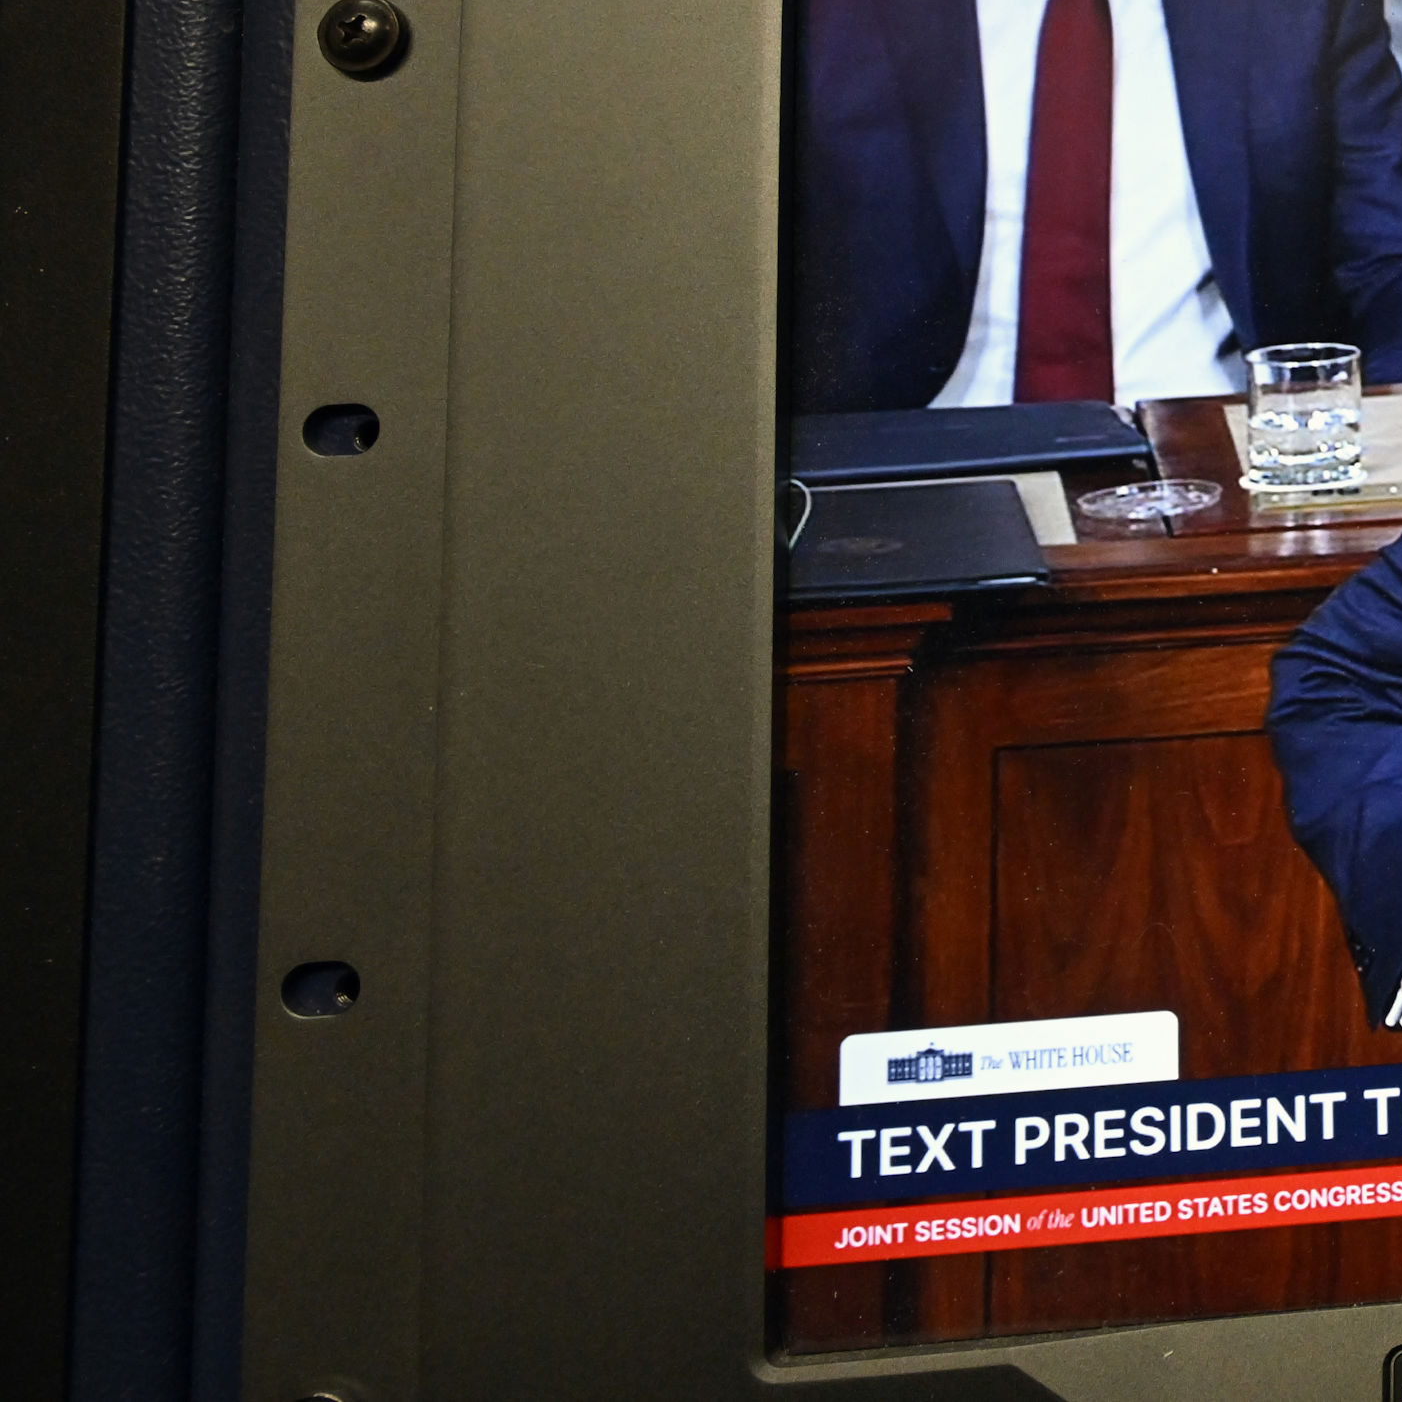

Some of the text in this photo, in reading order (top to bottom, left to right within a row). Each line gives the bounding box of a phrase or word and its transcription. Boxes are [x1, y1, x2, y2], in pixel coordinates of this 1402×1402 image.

[980, 1043, 1133, 1071] The WHITE HOUSE
[837, 1119, 997, 1179] TEXT
[1013, 1091, 1347, 1165] PRESIDENT
[834, 1222, 909, 1249] JOINT
[915, 1213, 1021, 1242] SESSION
[1026, 1209, 1047, 1231] of
[1047, 1208, 1075, 1230] the
[1081, 1200, 1172, 1228] UNITED
[1177, 1192, 1269, 1220] STATES
